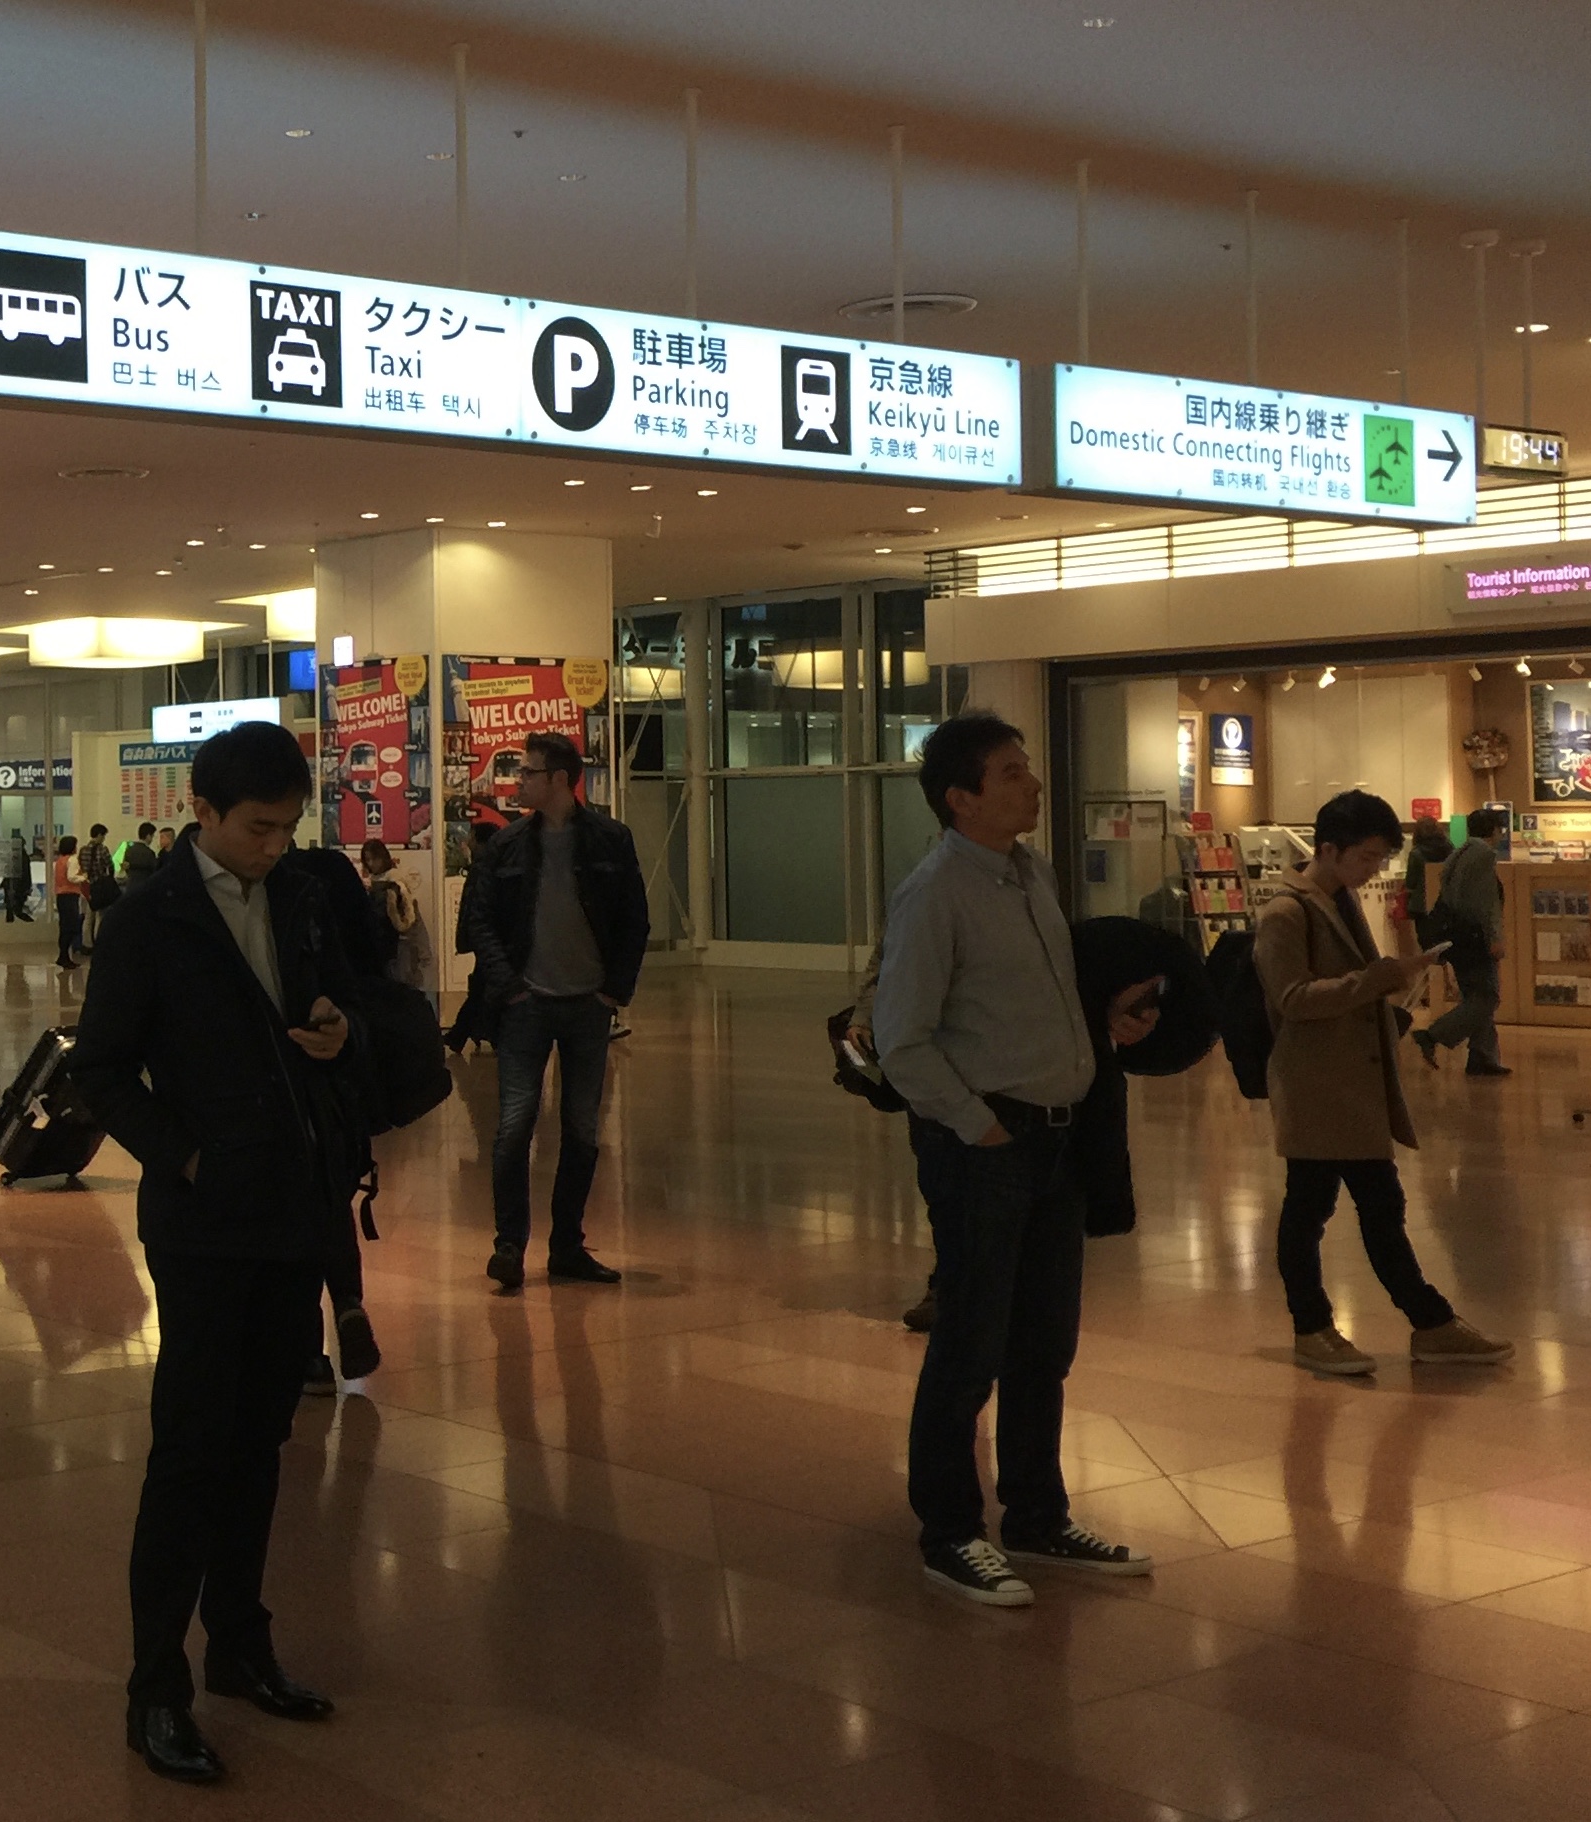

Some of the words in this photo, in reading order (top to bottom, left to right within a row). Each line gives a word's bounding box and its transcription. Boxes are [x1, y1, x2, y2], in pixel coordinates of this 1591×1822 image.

[113, 266, 191, 311] バス
[256, 288, 333, 326] TAXI
[365, 296, 506, 341] タクシー
[113, 318, 169, 352] Bus
[633, 328, 728, 374] 駐車場
[113, 361, 158, 387] 巴士
[177, 367, 222, 392] 버스
[365, 345, 422, 379] Taxi
[869, 357, 954, 399] 京急線
[365, 386, 426, 414] 出租车
[443, 394, 481, 419] 택시
[633, 376, 729, 418] Parking
[634, 413, 688, 440] 停车场
[704, 420, 758, 445] 주차장
[869, 400, 946, 435] Keikyū
[955, 410, 1000, 439] Line
[1186, 394, 1351, 442] 国内線乗り継ぎ
[869, 437, 918, 461] 京急线
[932, 442, 995, 468] 게이큐선
[1070, 420, 1166, 454] Domestic
[1172, 431, 1283, 472] Connecting
[1290, 444, 1351, 474] Flights
[1502, 433, 1558, 466] 19:44
[1212, 468, 1268, 492] 国内转机
[1467, 570, 1511, 588] Tourist
[1513, 564, 1590, 584] Information
[336, 692, 406, 723] WELCOME!
[357, 717, 385, 730] Subway
[385, 712, 408, 725] Ticket
[469, 698, 579, 729] WELCOME!
[472, 731, 504, 747] Tokyo
[1543, 818, 1568, 828] Tokyo
